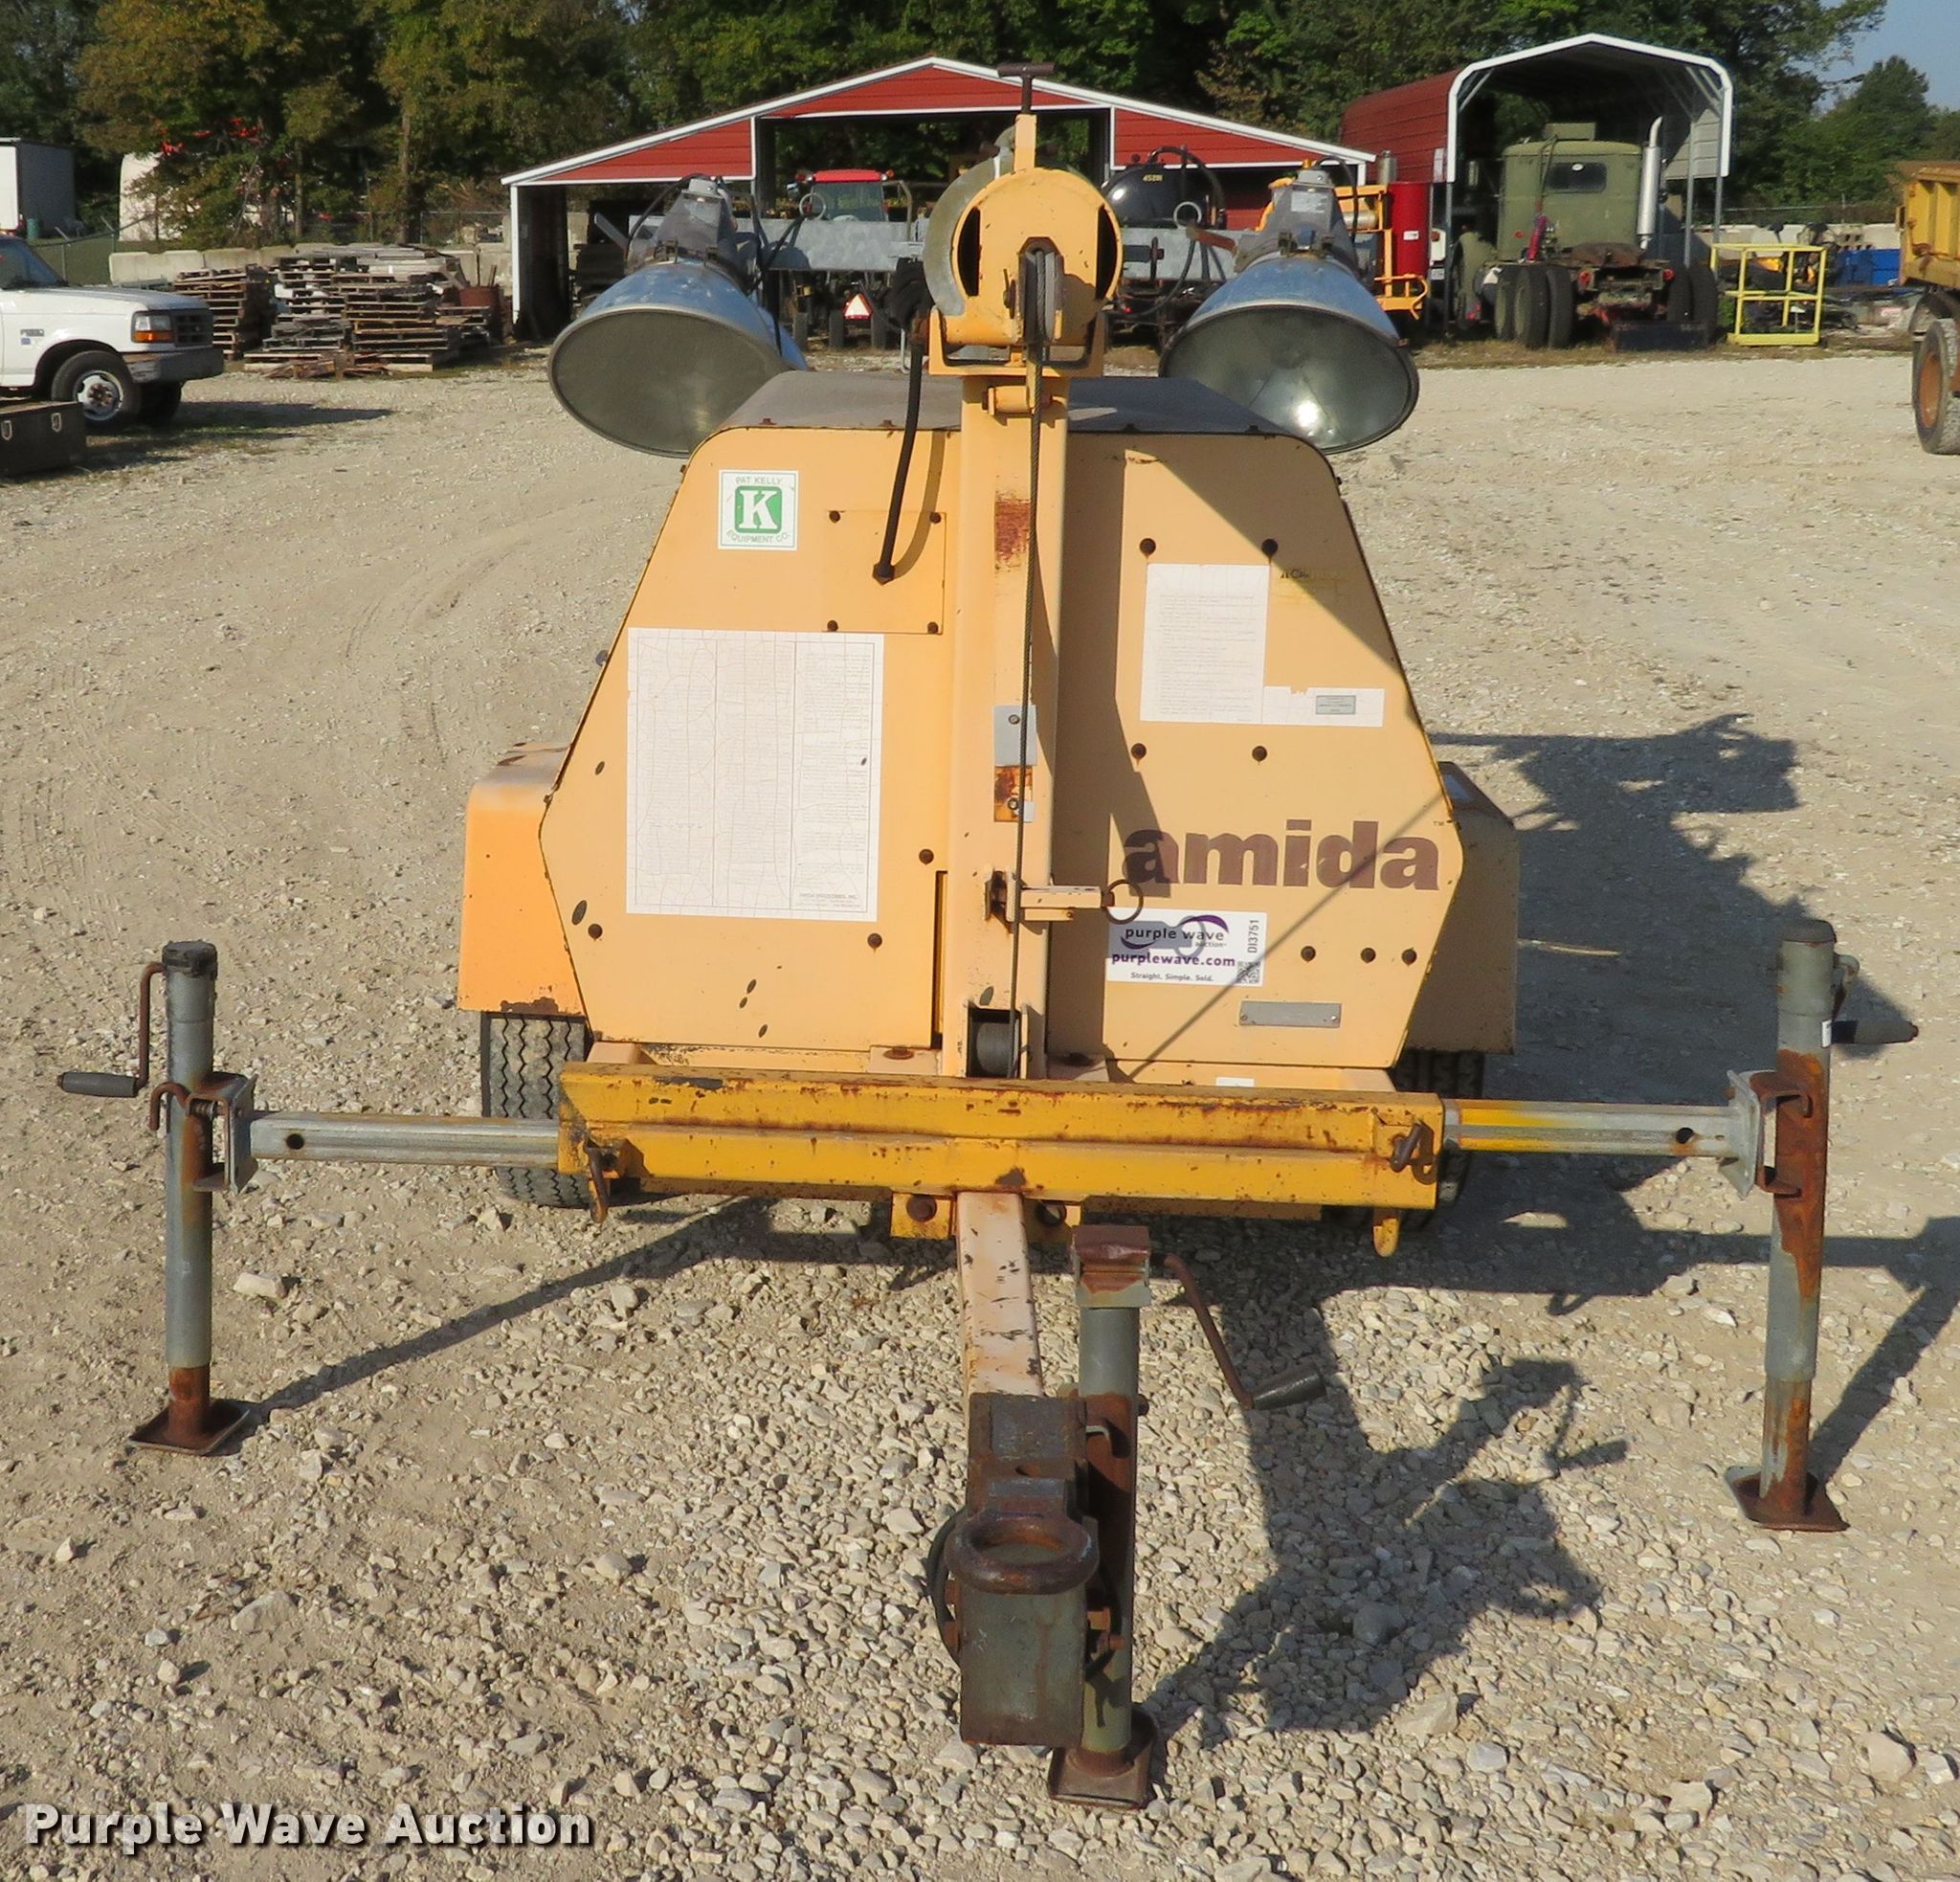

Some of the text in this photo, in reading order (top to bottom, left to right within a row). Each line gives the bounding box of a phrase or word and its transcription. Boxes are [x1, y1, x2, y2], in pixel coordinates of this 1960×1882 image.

[754, 476, 782, 484] KELLY
[738, 489, 778, 529] K
[726, 529, 773, 543] EQUIPMENT
[1123, 819, 1439, 891] amida
[1125, 928, 1224, 941] purple wave
[1111, 952, 1236, 967] purplewave.com
[1131, 972, 1162, 980] Straight.
[1166, 973, 1192, 981] Simple.
